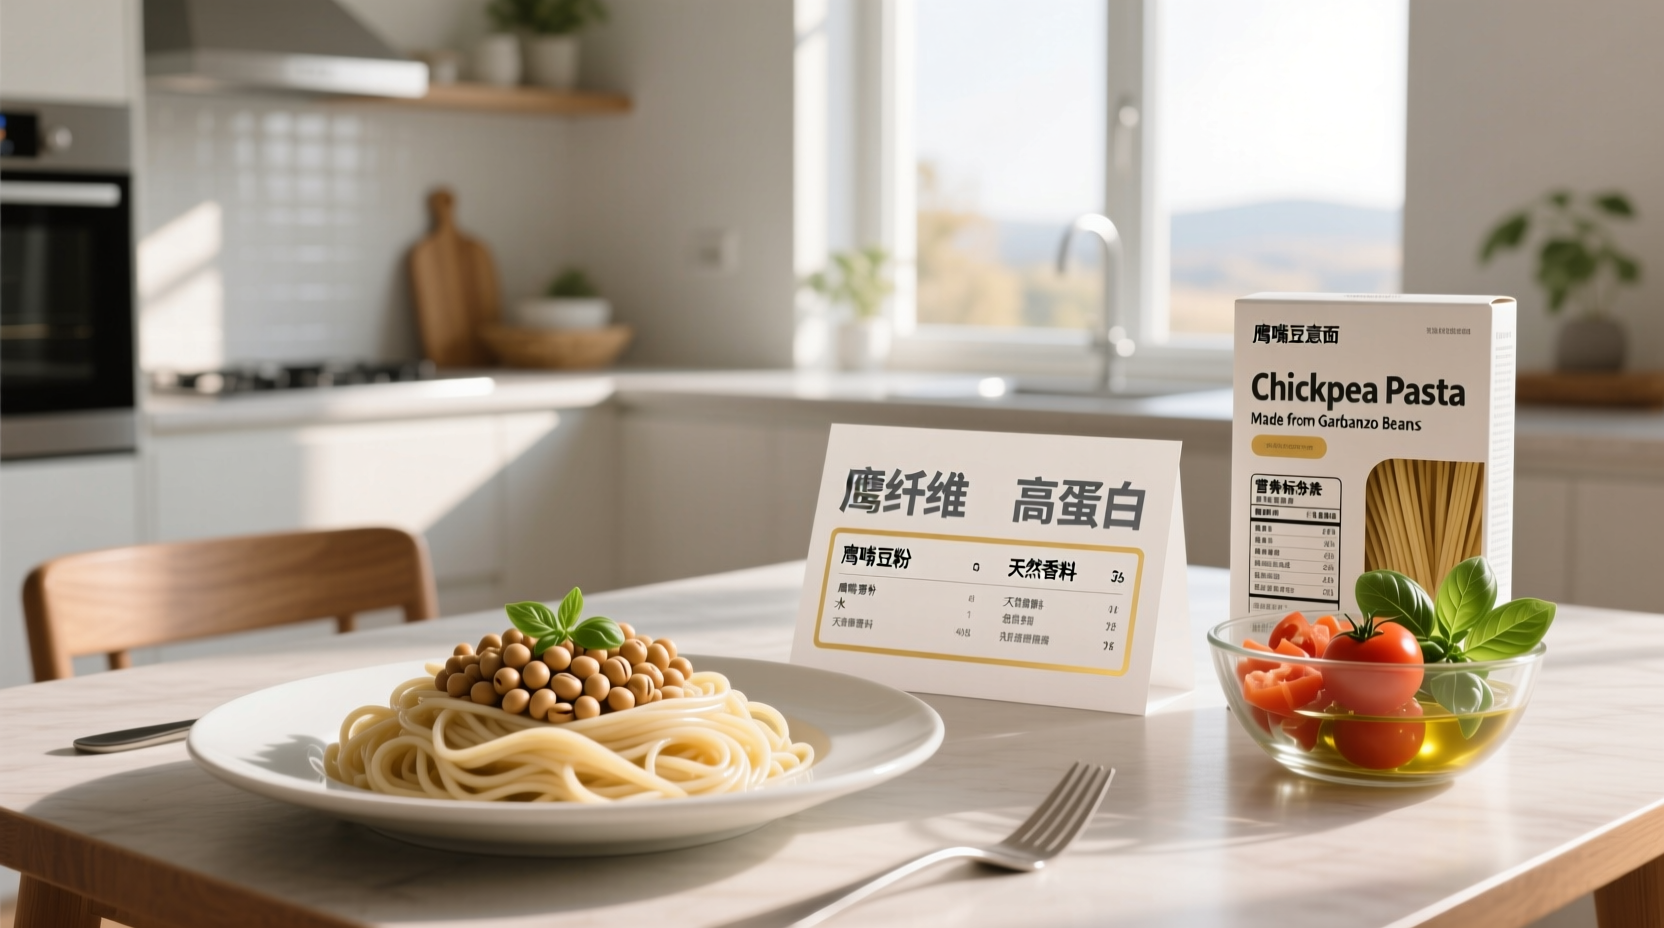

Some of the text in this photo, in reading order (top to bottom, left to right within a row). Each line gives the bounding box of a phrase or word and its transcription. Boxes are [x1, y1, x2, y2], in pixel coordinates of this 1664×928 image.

[1251, 371, 1466, 411] Chickpea Pasta
[1250, 412, 1422, 432] Made from Garbanzo Beans
[1012, 476, 1146, 531] 高蛋白
[1007, 558, 1078, 582] 天然香料
